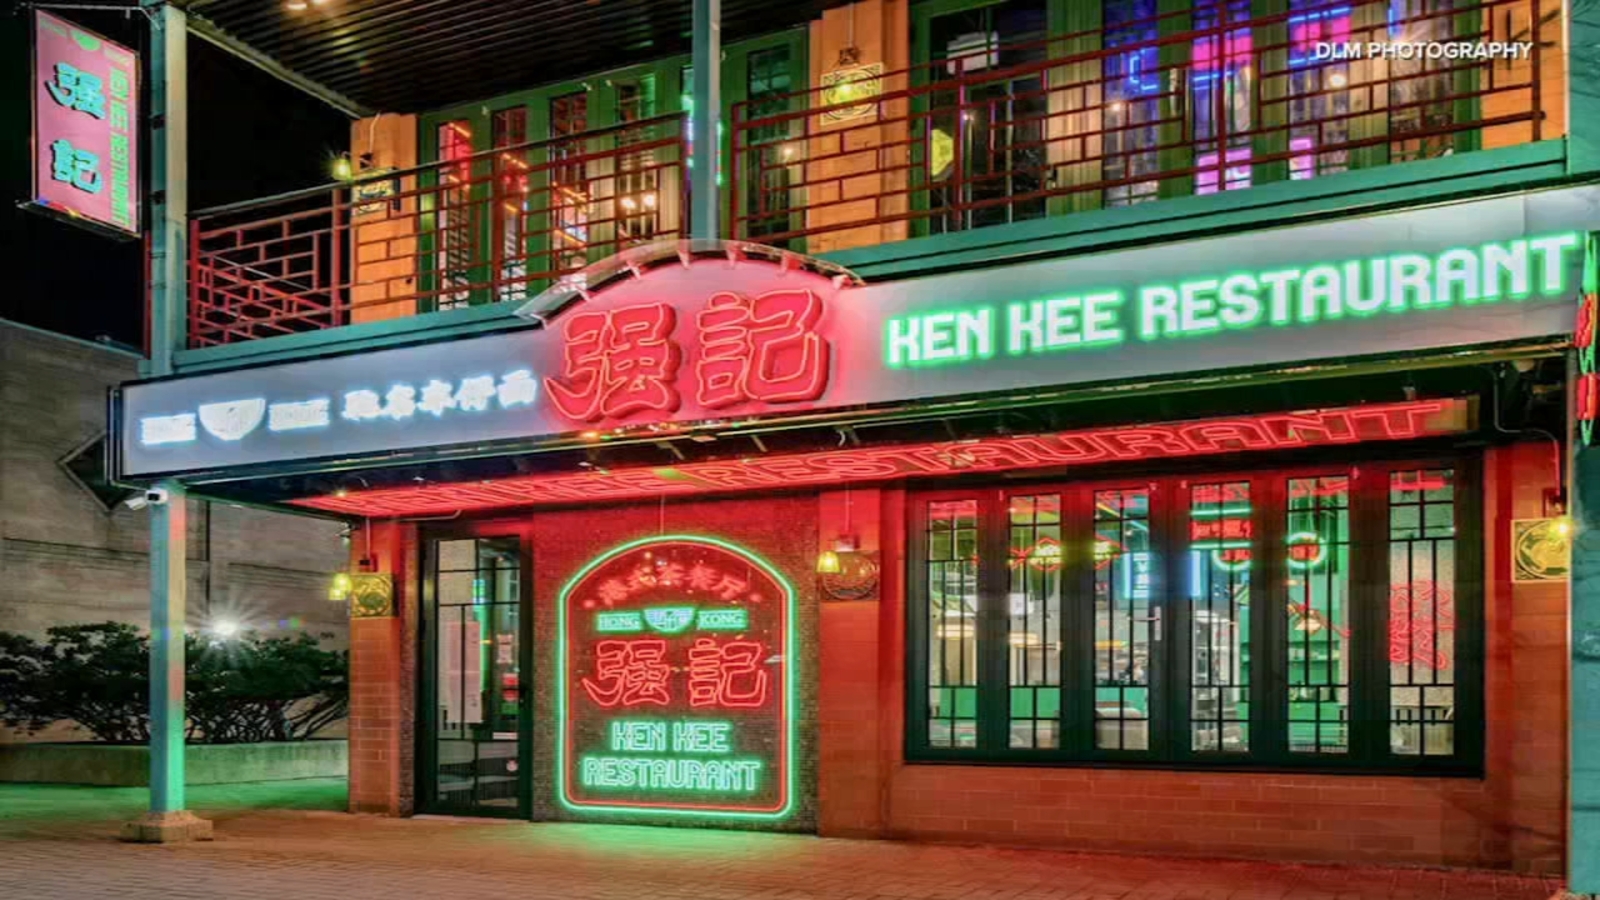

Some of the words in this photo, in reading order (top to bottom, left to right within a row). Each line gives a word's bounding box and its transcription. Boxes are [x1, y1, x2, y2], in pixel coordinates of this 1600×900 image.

[886, 309, 992, 366] KEN
[1008, 291, 1122, 354] KEE
[1138, 233, 1578, 340] RESTAURANT
[672, 402, 1442, 488] RESTAURANT
[698, 610, 748, 630] KONG
[611, 721, 666, 751] KEN
[673, 722, 731, 751] KEE
[583, 758, 761, 791] RESTAURANT
